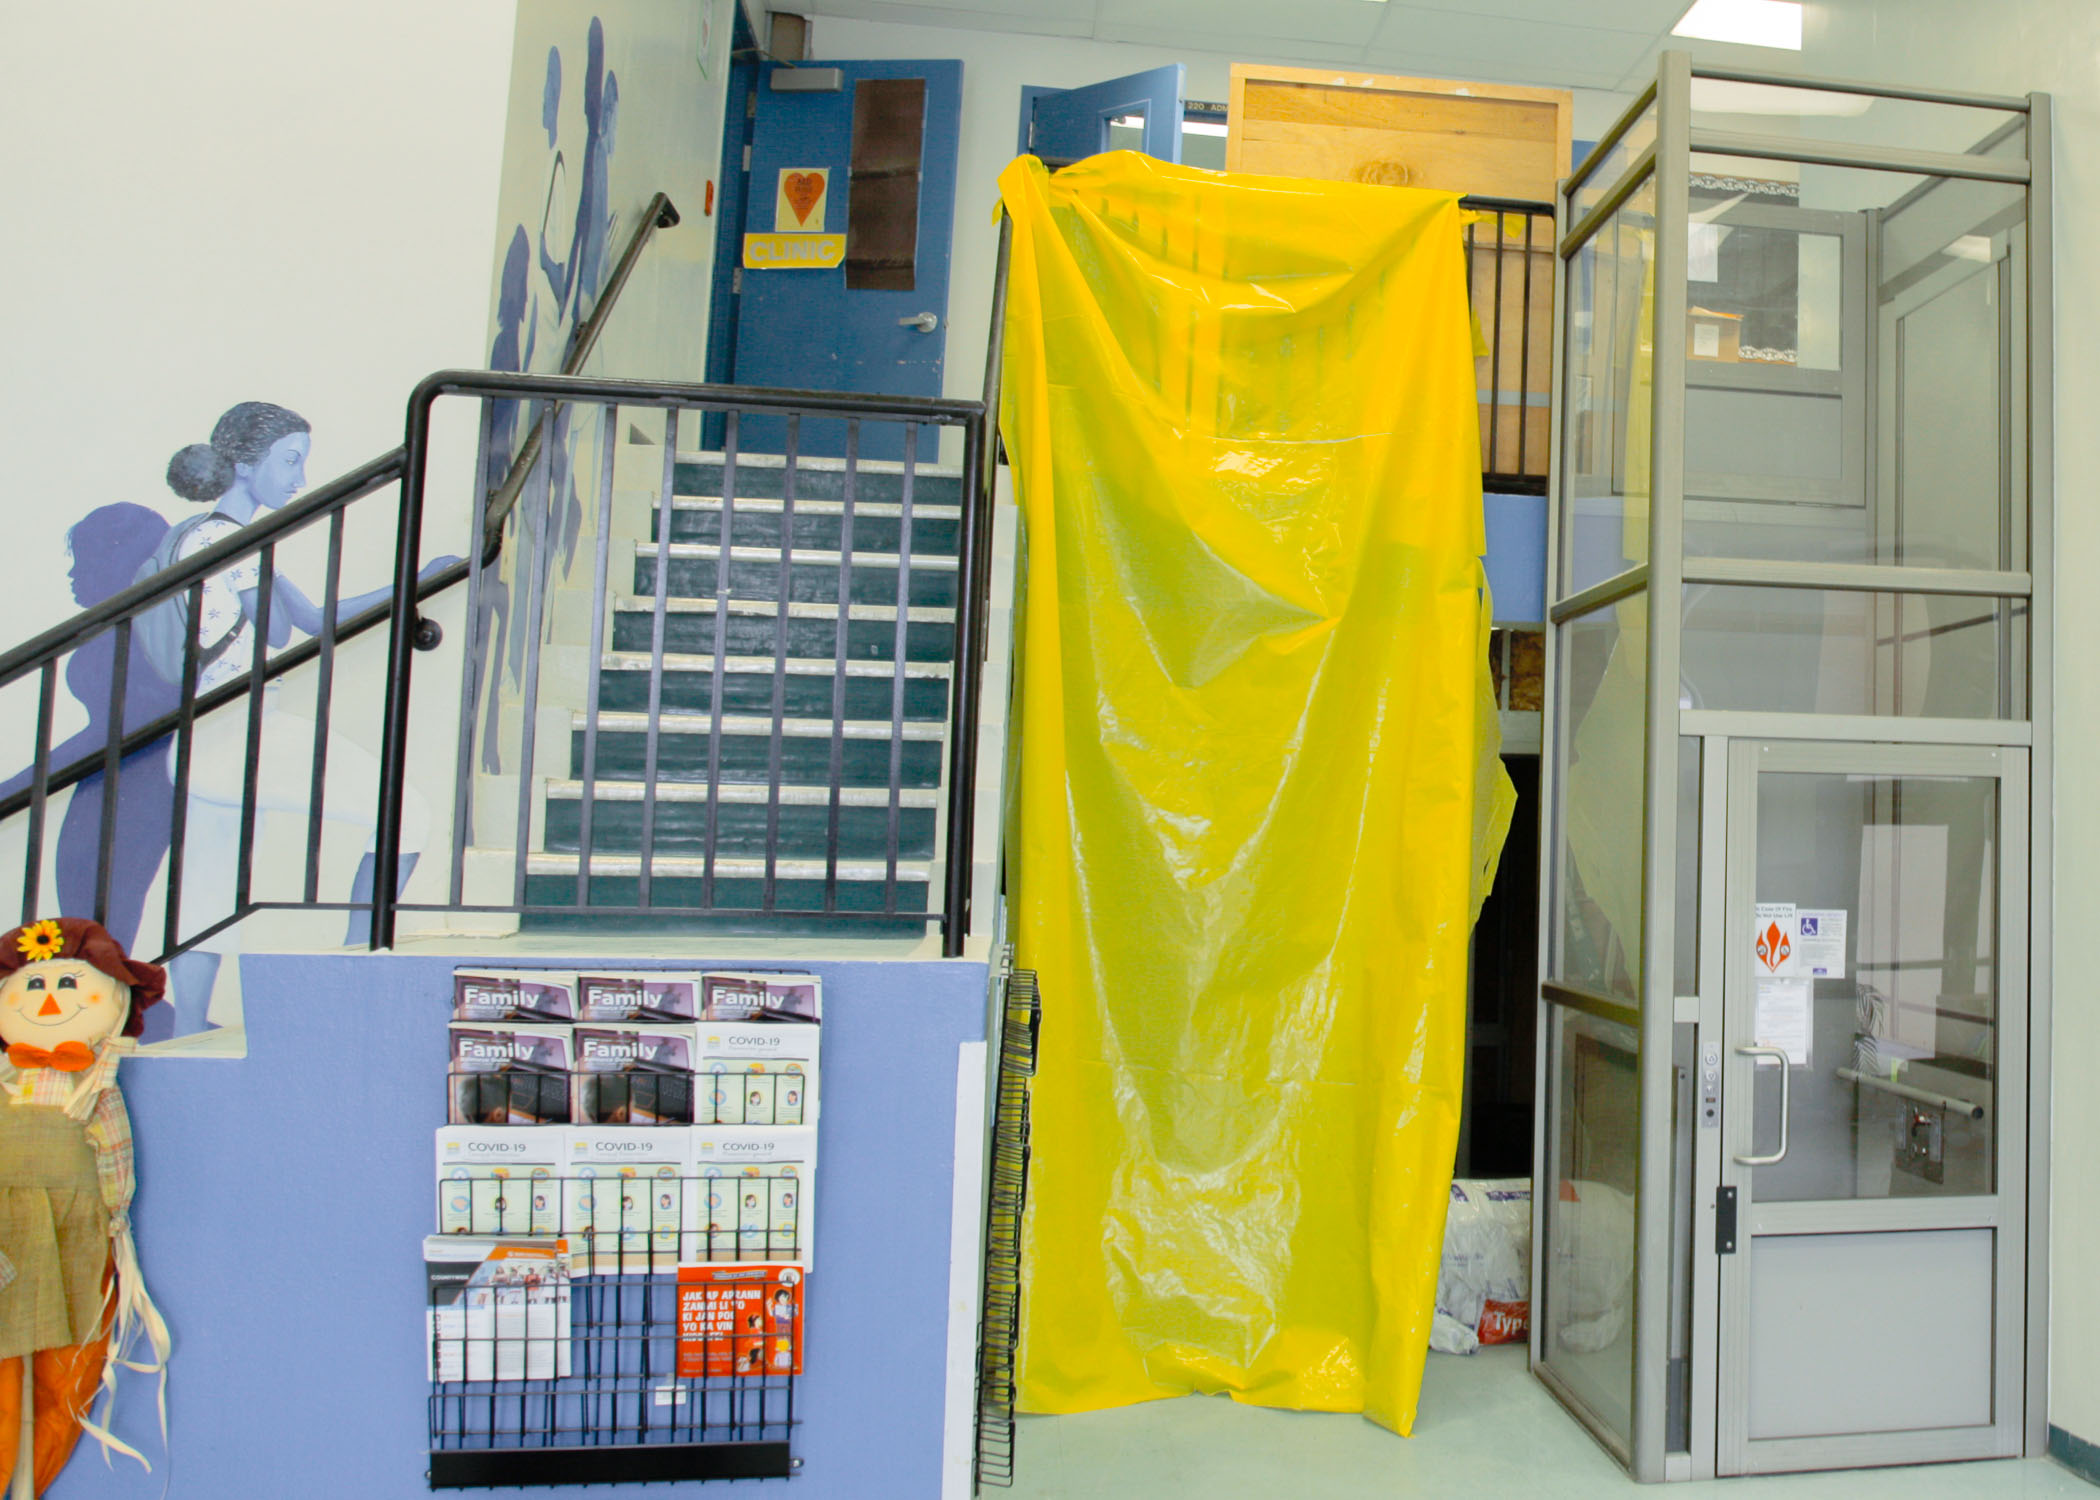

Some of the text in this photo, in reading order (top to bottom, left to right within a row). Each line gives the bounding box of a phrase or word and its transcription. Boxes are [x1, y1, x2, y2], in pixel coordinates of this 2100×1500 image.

[1187, 102, 1205, 110] 220
[749, 241, 835, 261] CLINIC
[465, 988, 540, 1008] Family
[589, 989, 663, 1008] Family
[712, 989, 785, 1009] Family
[728, 1036, 780, 1046] COVID-19
[459, 1041, 535, 1060] Family
[583, 1041, 658, 1060] Family
[468, 1142, 526, 1152] COVID-19
[595, 1142, 653, 1152] COVID-19
[722, 1142, 775, 1151] COVID-19
[682, 1291, 703, 1301] JAK
[719, 1301, 729, 1310] LI
[682, 1312, 693, 1321] KI
[682, 1322, 697, 1331] YO
